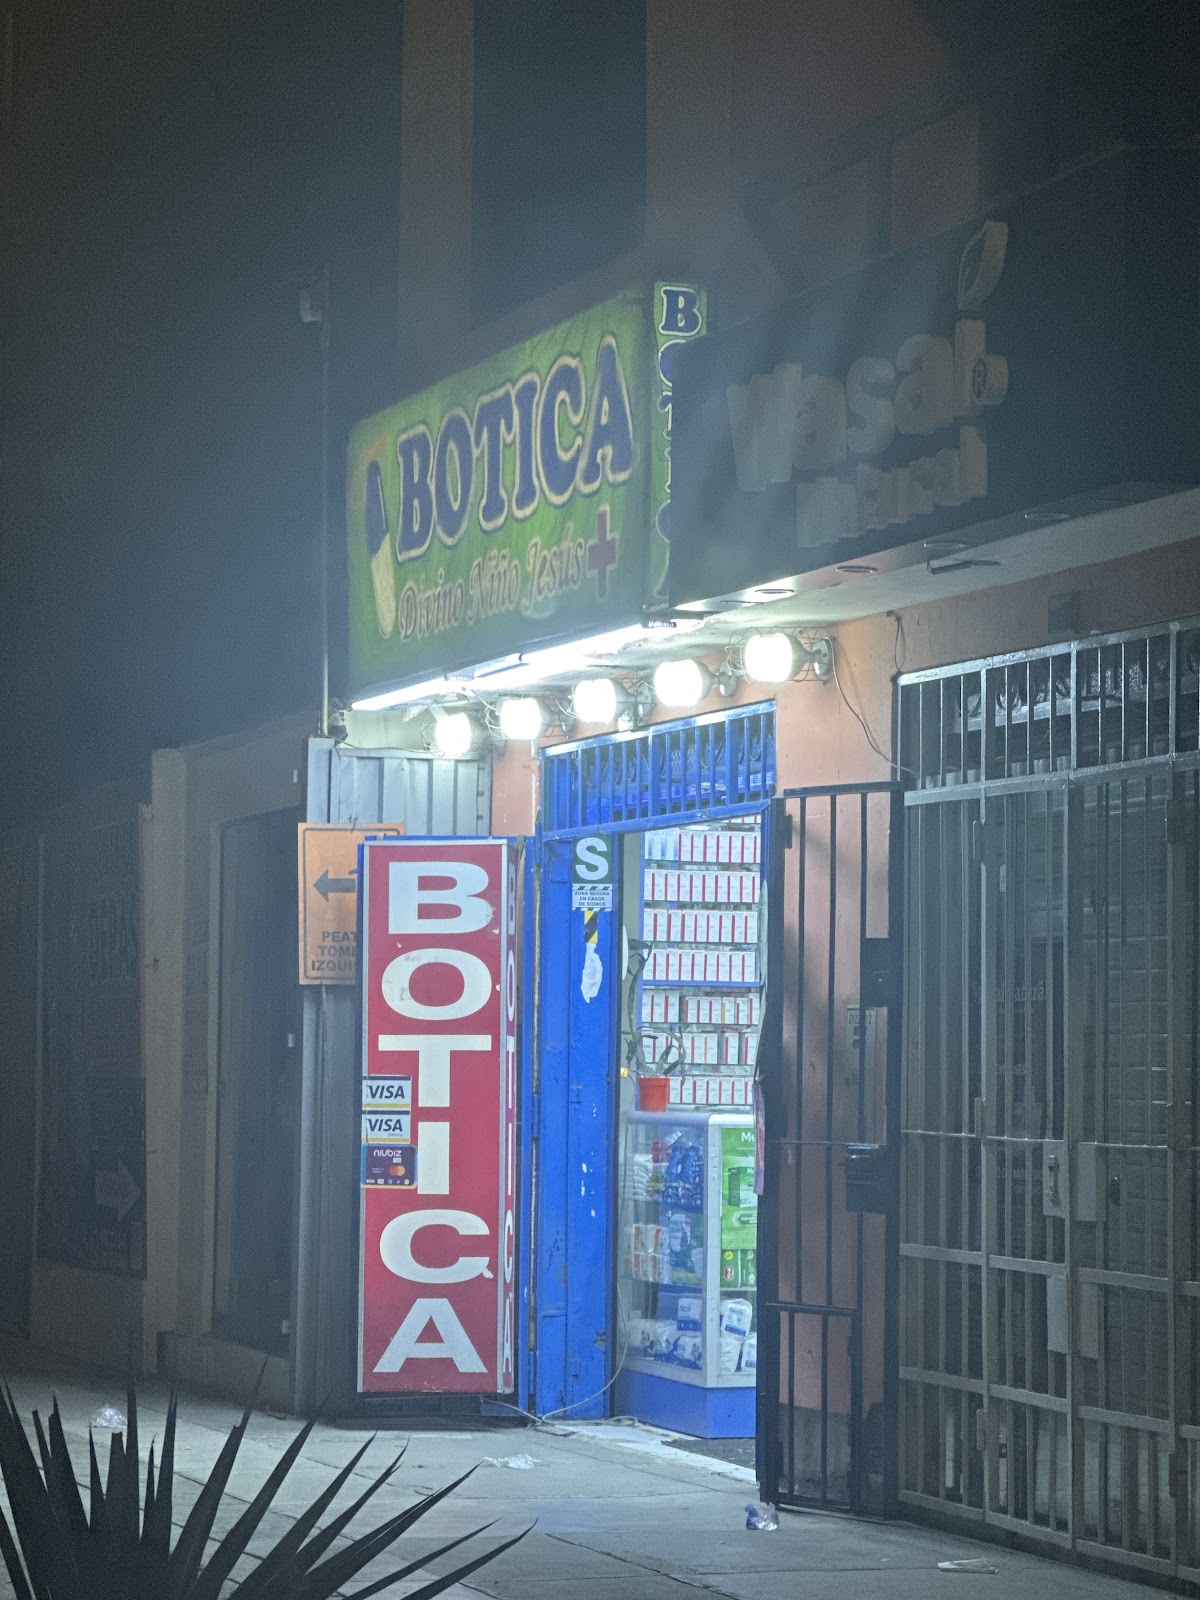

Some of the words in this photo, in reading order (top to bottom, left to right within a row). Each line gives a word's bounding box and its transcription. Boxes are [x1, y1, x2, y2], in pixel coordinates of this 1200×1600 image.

[396, 333, 634, 563] BOTICA
[400, 567, 464, 641] Divino
[466, 548, 520, 624] Niño
[575, 836, 609, 880] S
[367, 1085, 405, 1099] VISA
[366, 1118, 403, 1132] VISA
[373, 861, 493, 1374] BOTICA
[373, 1149, 402, 1157] niubiz
